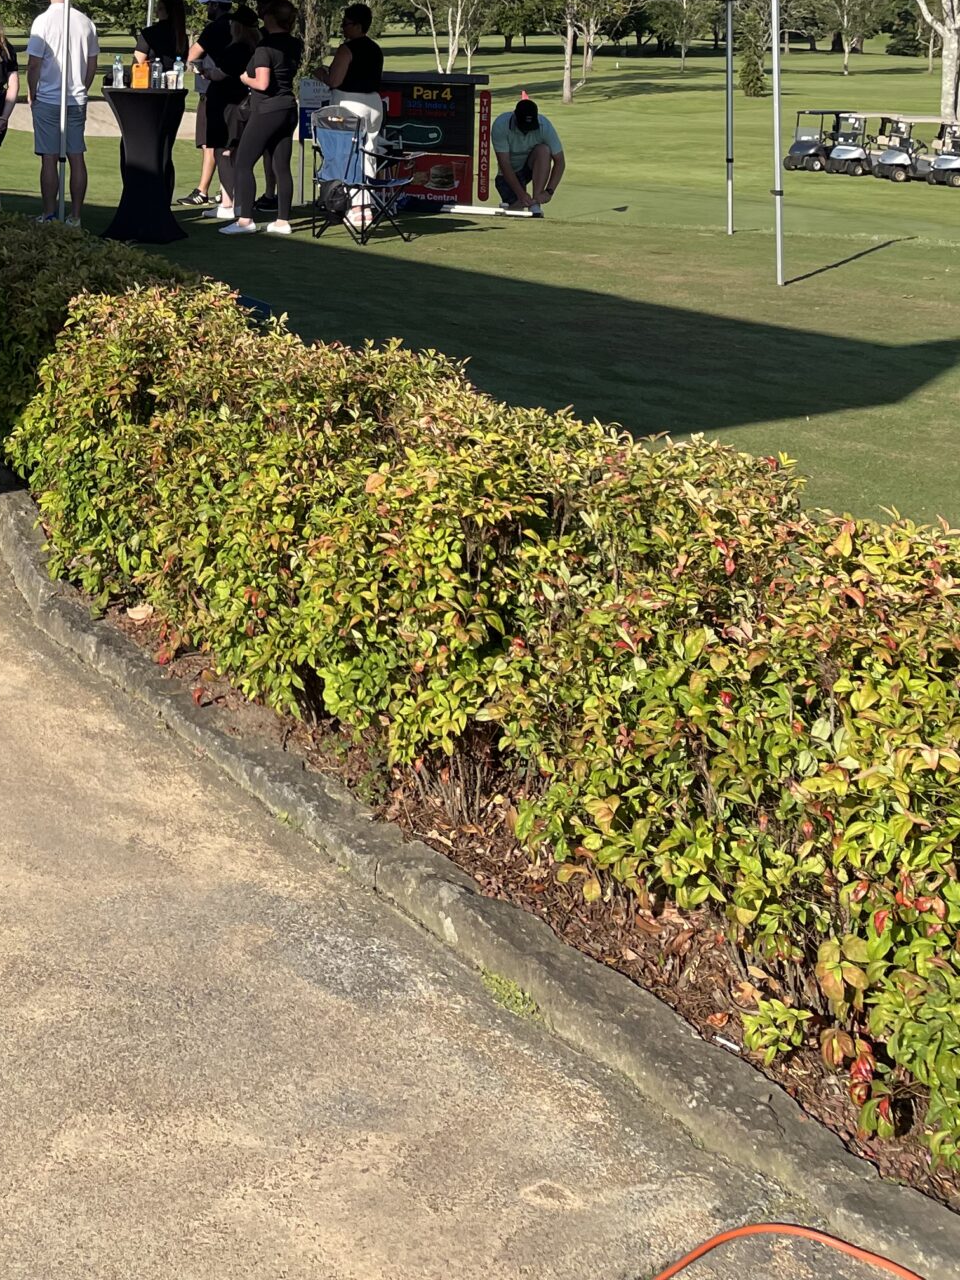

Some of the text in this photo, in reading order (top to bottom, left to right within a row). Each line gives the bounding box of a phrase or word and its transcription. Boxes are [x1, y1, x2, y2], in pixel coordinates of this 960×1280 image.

[413, 86, 453, 101] Par 4
[480, 98, 489, 193] THE PINNACLES
[427, 193, 458, 202] Central
